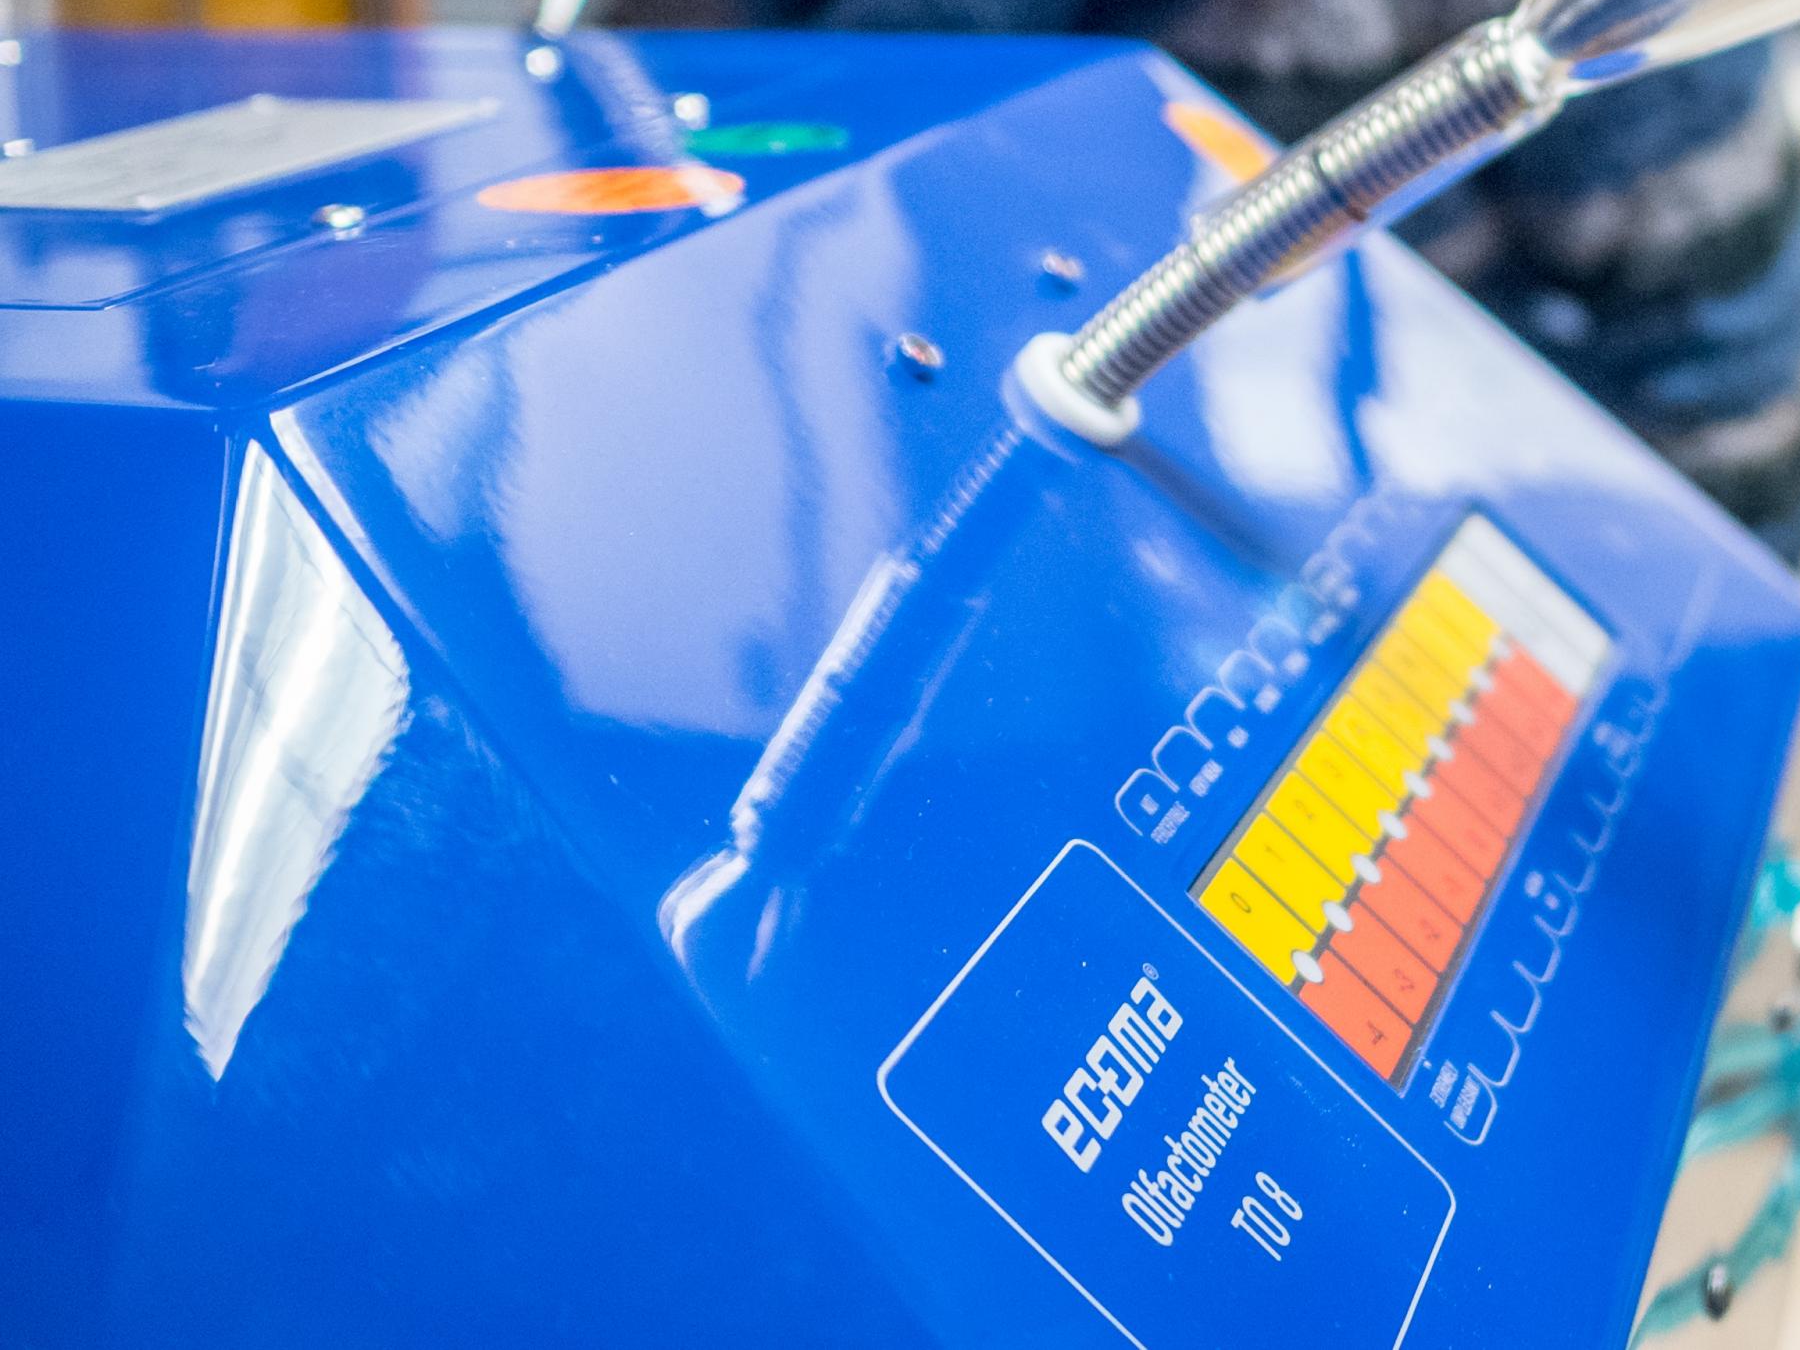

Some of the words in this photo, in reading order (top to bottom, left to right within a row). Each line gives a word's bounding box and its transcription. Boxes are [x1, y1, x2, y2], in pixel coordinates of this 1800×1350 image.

[1121, 1056, 1257, 1247] Olfactometer
[1230, 1195, 1291, 1262] TO
[1255, 1171, 1303, 1221] 8
